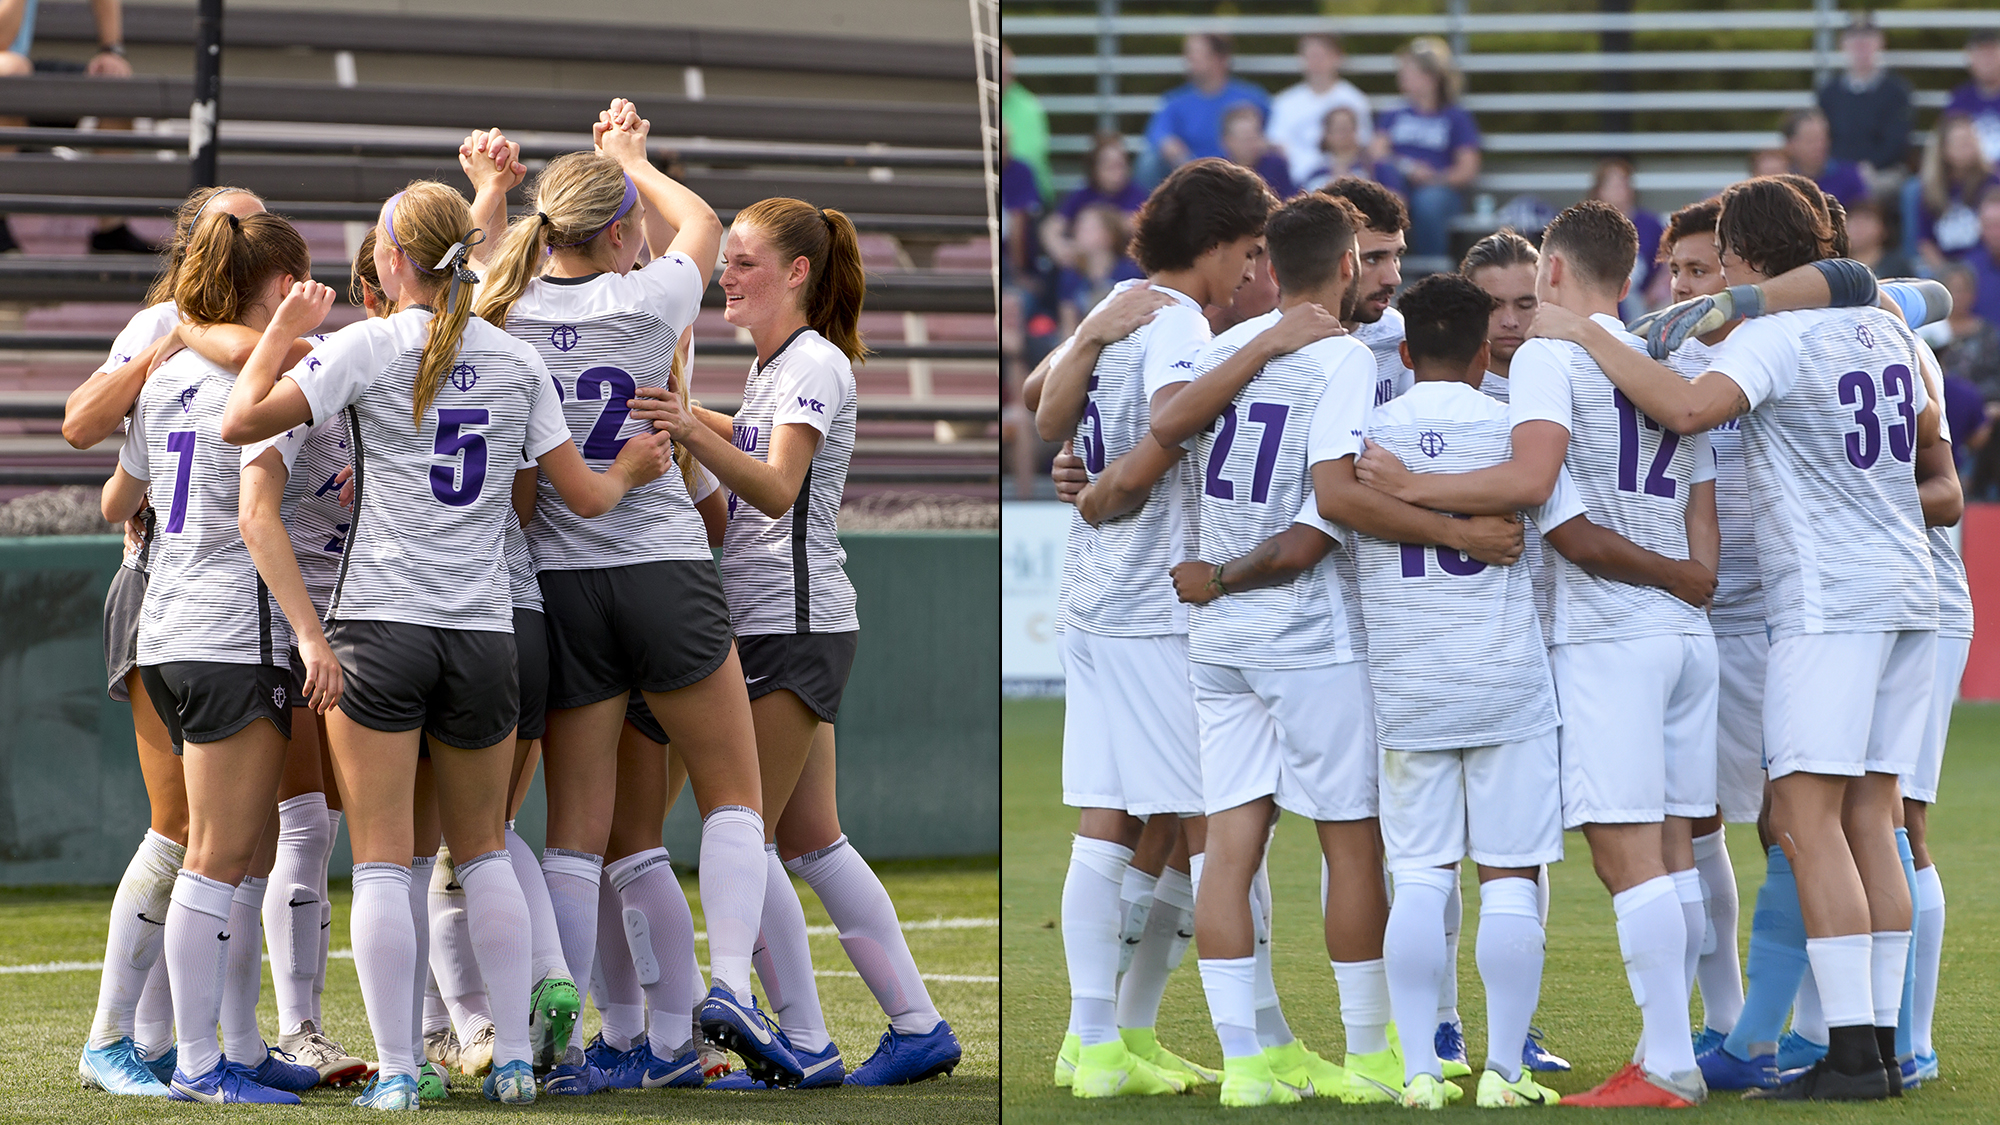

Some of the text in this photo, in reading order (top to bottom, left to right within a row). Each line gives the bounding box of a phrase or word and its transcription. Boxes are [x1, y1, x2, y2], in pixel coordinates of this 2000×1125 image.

[428, 408, 489, 506] 5
[551, 366, 636, 460] 2
[1205, 402, 1289, 504] 27
[1614, 388, 1677, 499] 12
[1838, 364, 1915, 470] 33
